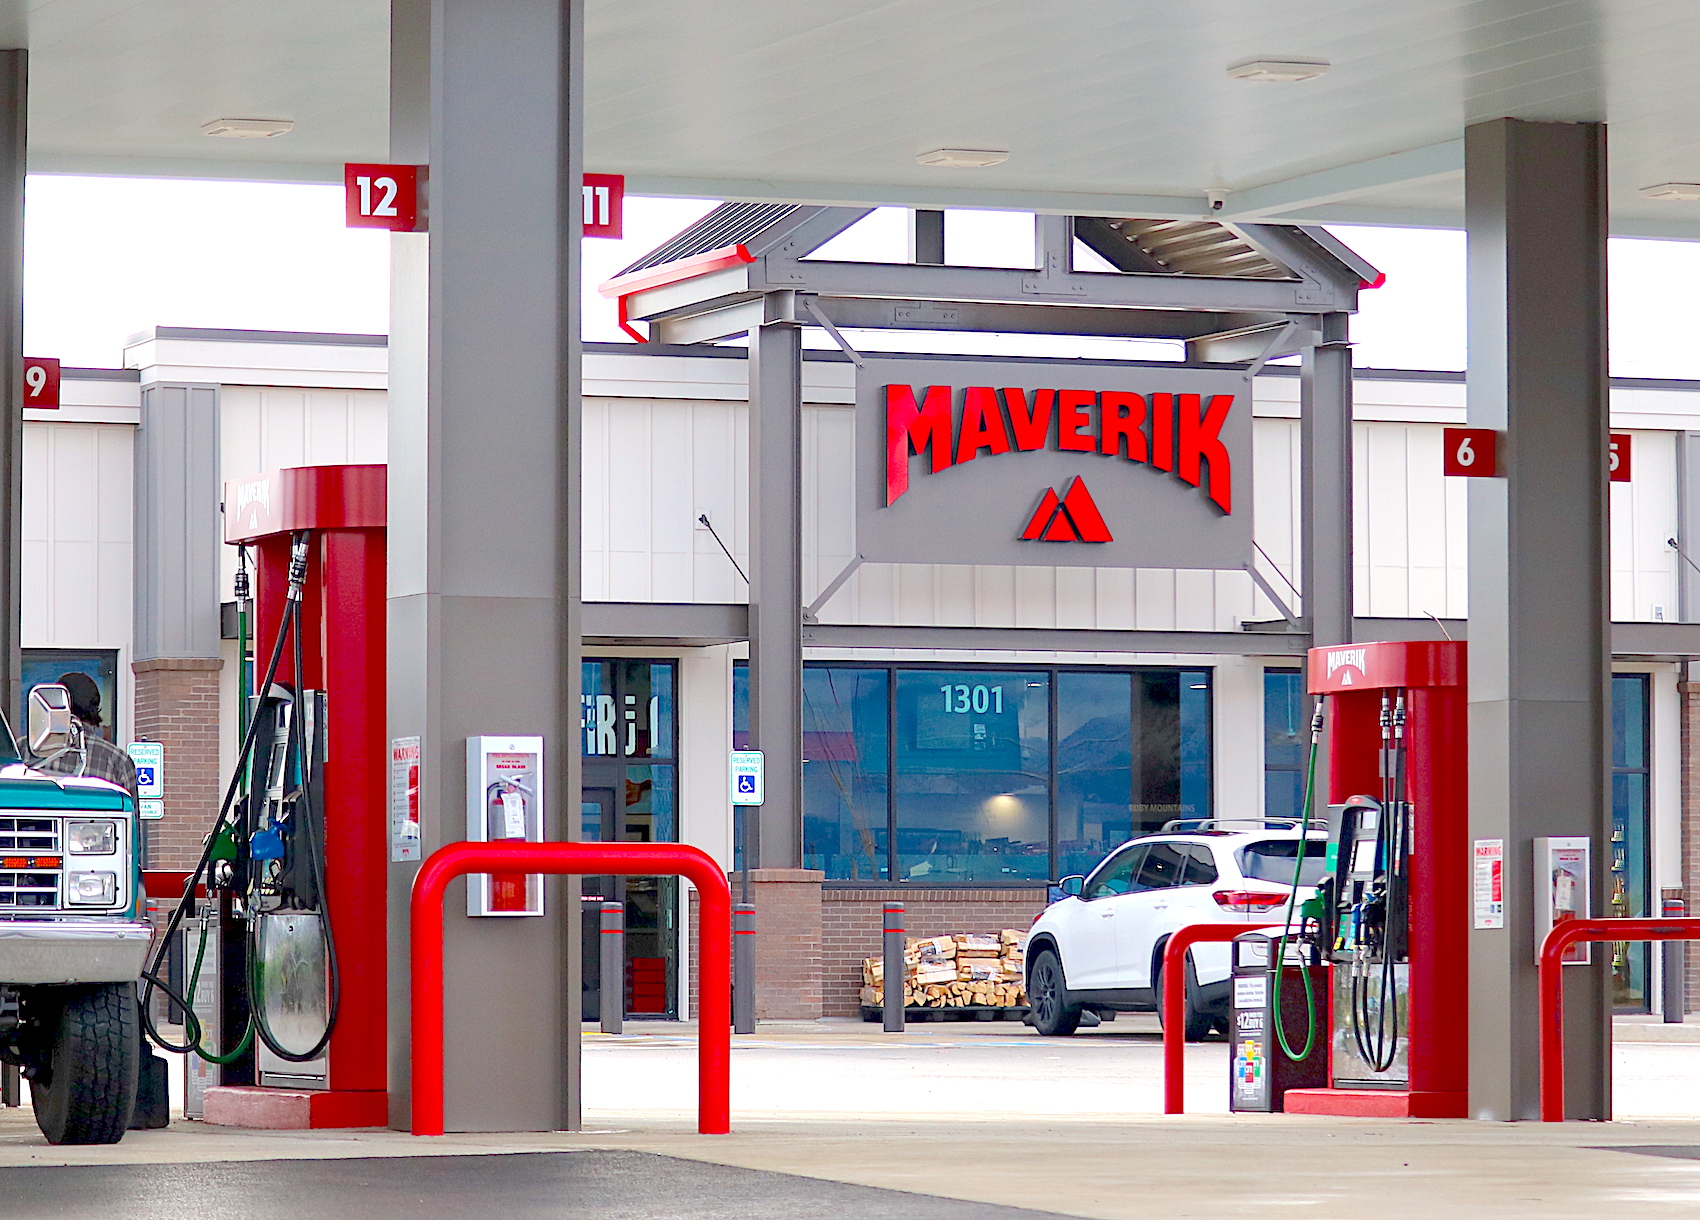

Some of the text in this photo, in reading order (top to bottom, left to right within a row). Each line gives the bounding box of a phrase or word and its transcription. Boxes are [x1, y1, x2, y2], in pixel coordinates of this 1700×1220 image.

[356, 176, 398, 216] 12
[582, 185, 610, 225] 11
[26, 366, 46, 397] 9
[885, 383, 1235, 517] MAVERIK
[1456, 437, 1475, 467] 6
[236, 478, 271, 523] MAVERIK
[1326, 648, 1366, 680] MAVERIK
[940, 684, 1003, 714] 1301
[130, 748, 160, 756] RESERVED
[393, 745, 419, 761] WARNING
[733, 756, 760, 764] RESERVED
[1128, 803, 1196, 812] RUBY MOUNTAINS
